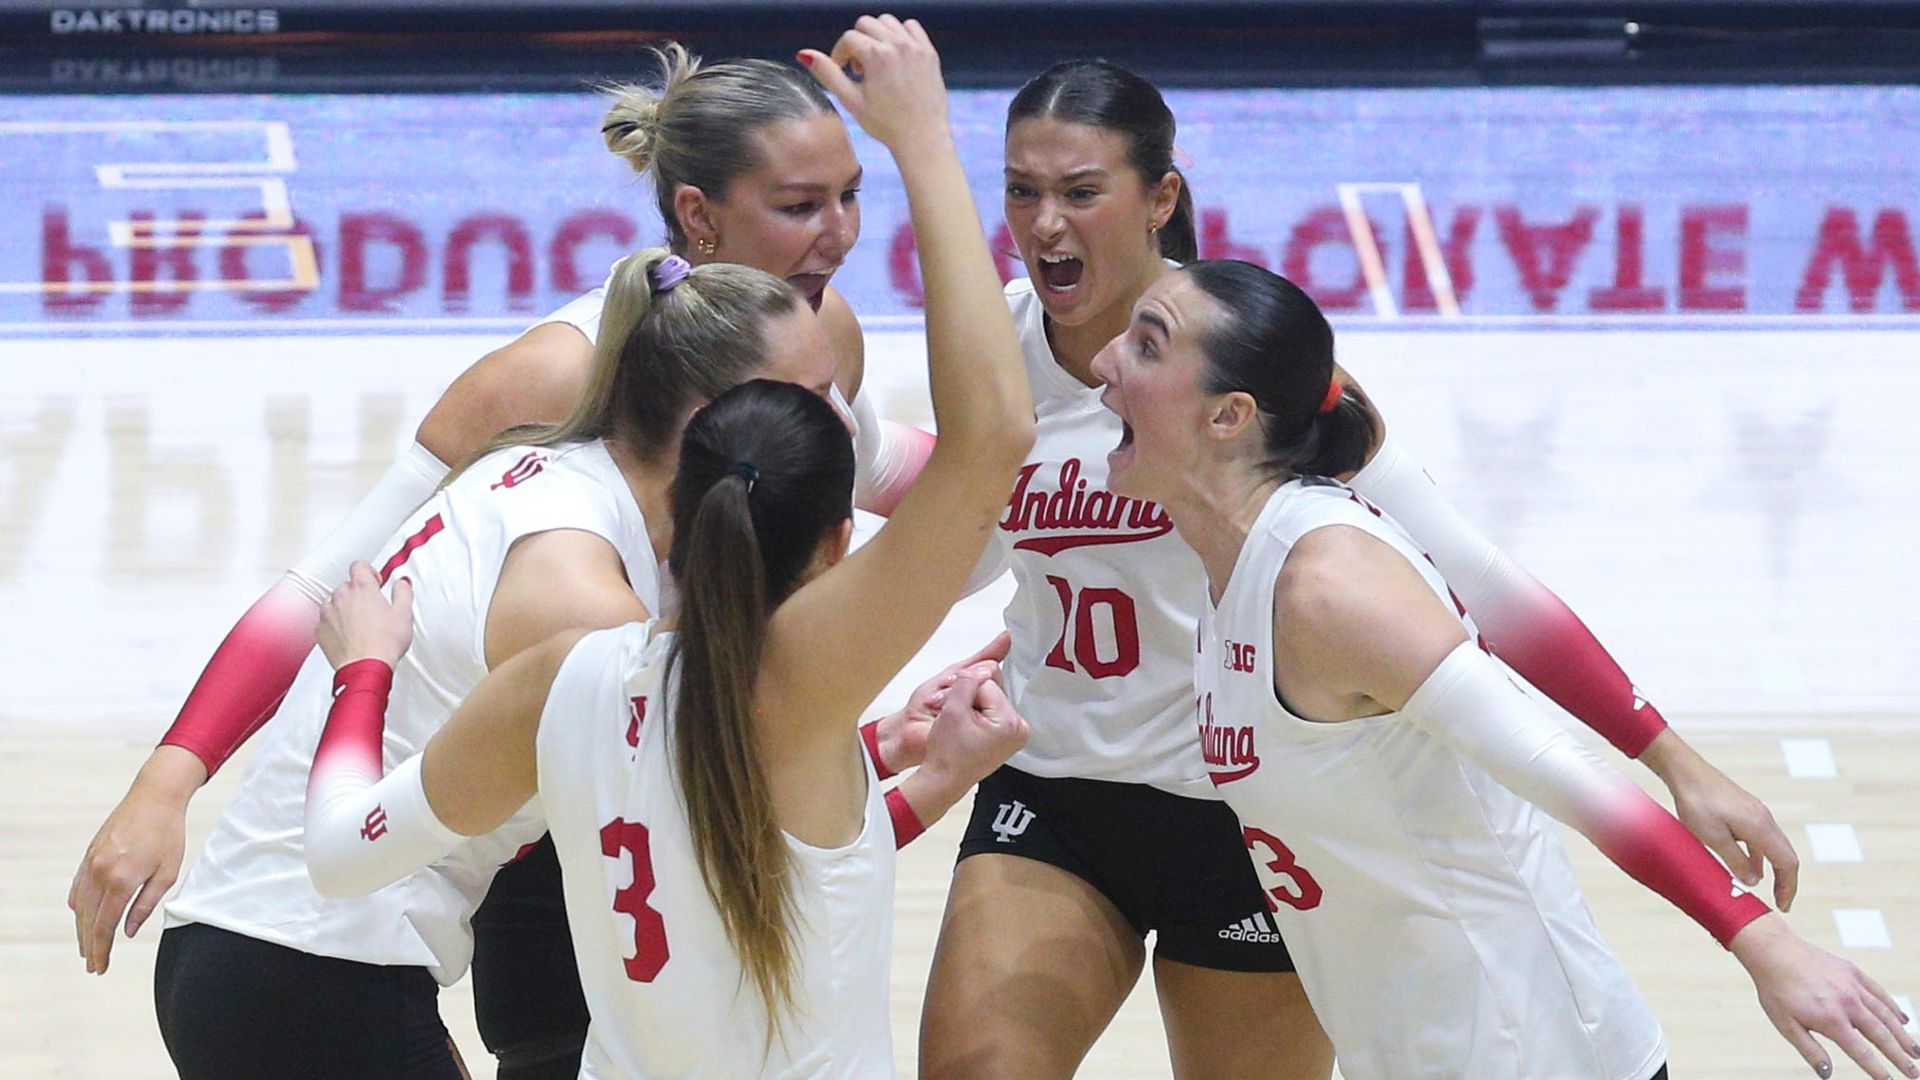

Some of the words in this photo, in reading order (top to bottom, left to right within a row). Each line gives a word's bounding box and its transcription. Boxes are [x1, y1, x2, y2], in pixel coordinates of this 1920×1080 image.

[50, 9, 279, 33] DAKTRONICS
[1242, 825, 1323, 913] 3
[600, 816, 670, 983] 3
[1217, 928, 1280, 944] adidas
